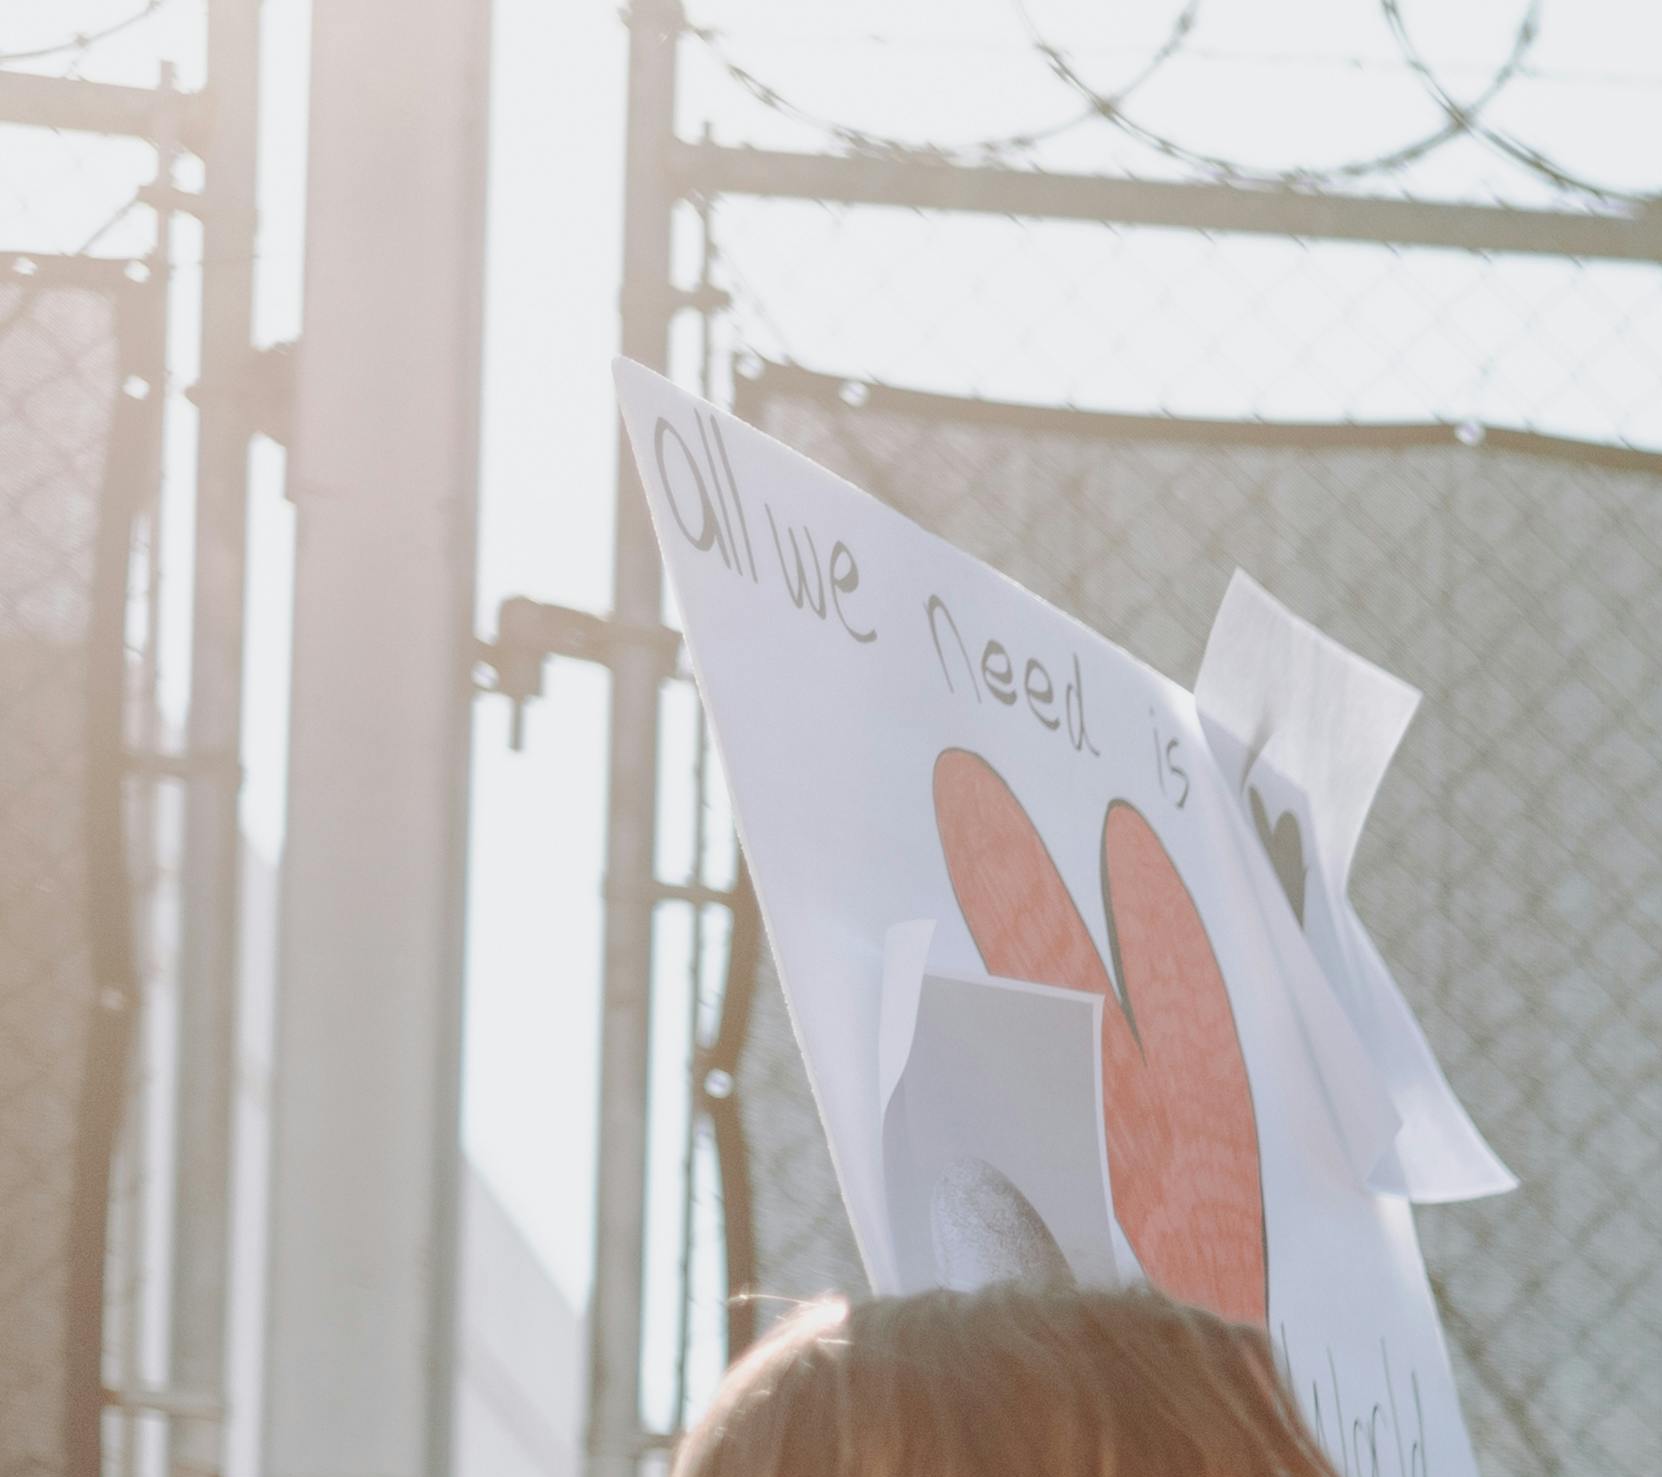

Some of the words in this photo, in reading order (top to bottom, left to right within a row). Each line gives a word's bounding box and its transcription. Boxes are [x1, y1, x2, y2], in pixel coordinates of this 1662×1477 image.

[763, 501, 879, 643] we
[922, 594, 1102, 759] need
[1149, 706, 1191, 809] is
